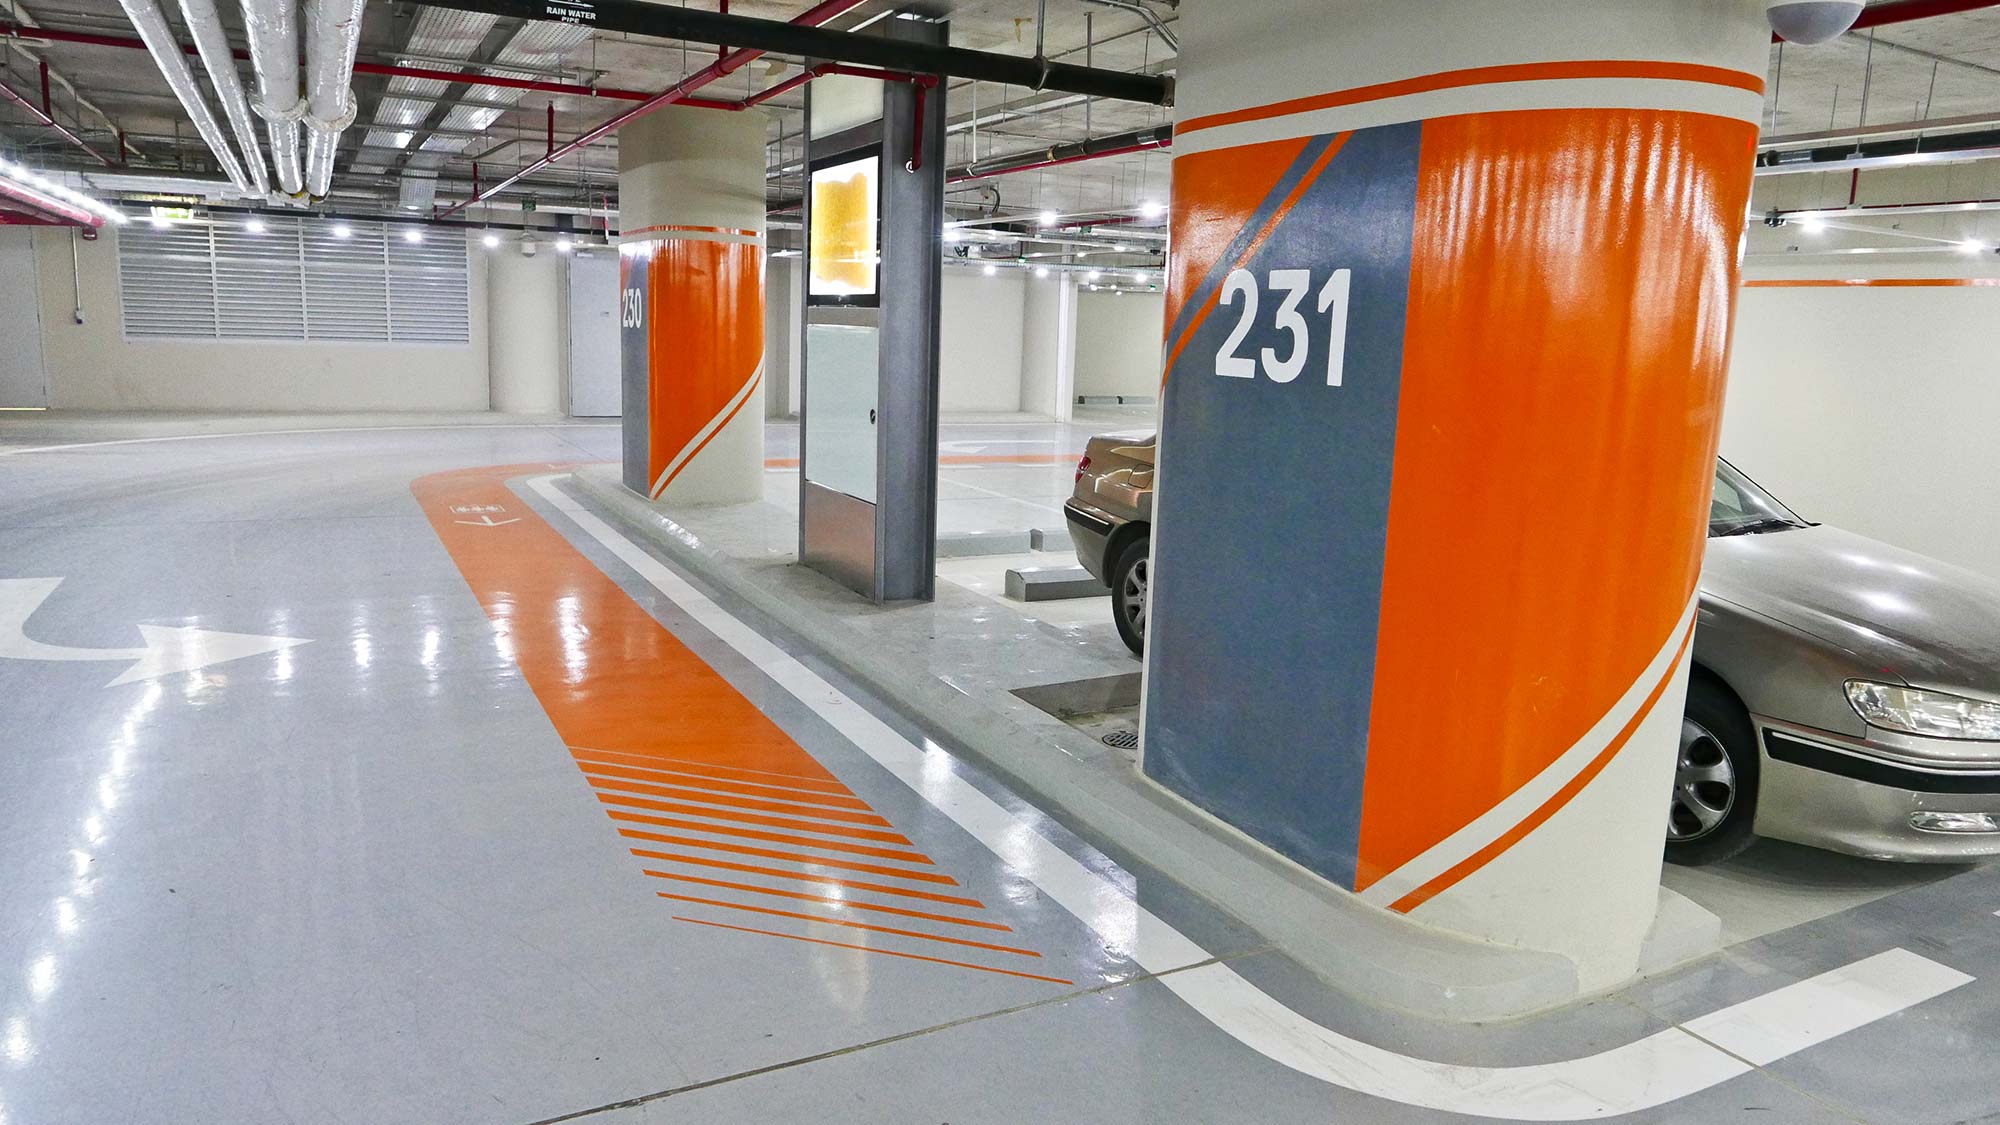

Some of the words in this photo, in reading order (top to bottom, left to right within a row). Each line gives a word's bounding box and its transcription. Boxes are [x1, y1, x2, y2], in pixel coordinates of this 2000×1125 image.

[546, 6, 567, 16] RAIN
[568, 9, 597, 20] WATER
[561, 16, 580, 24] PIPE
[622, 287, 642, 329] 230
[1215, 268, 1351, 387] 231
